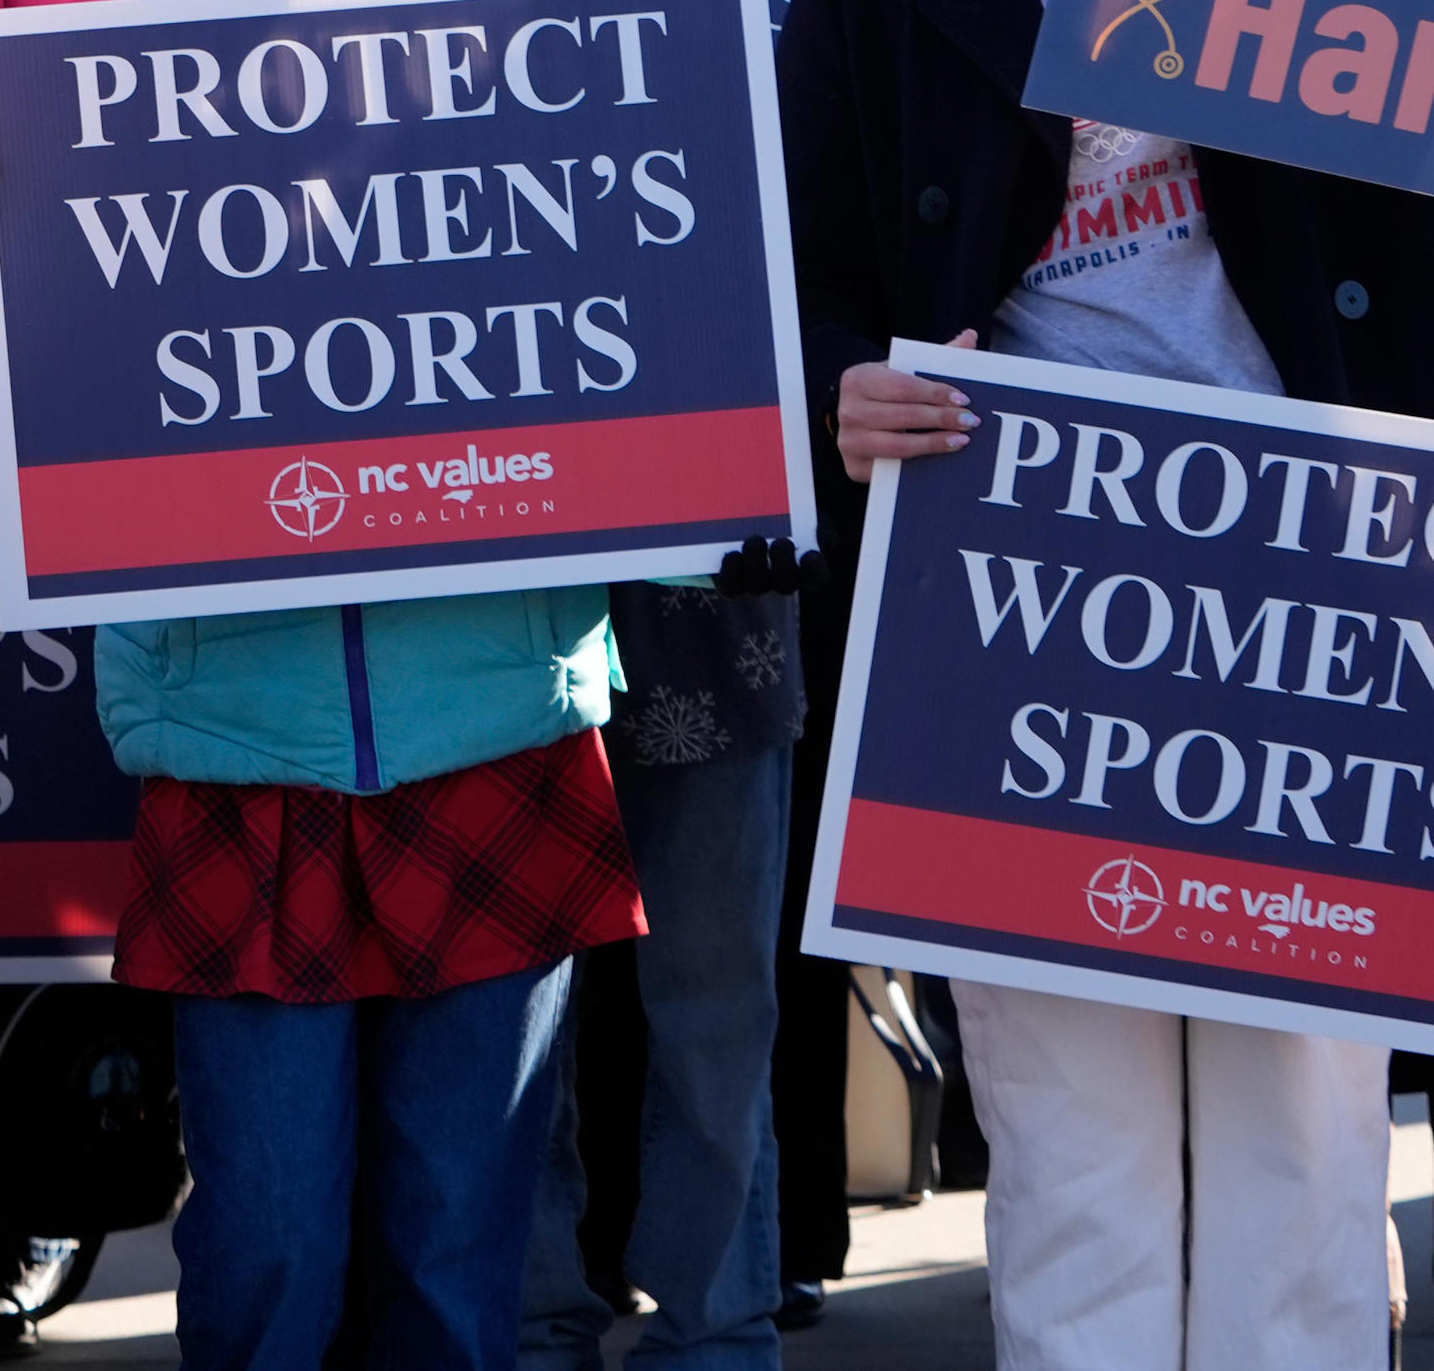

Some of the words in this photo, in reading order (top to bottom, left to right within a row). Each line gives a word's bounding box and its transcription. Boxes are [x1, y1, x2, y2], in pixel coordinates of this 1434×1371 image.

[63, 10, 668, 151] PROTECT
[64, 148, 697, 290] WOMEN'S
[156, 294, 638, 428] SPORTS
[359, 462, 407, 494] nc
[416, 445, 554, 488] values
[363, 499, 555, 528] COALITION
[979, 410, 1434, 569] PROTE
[958, 547, 1434, 714] WOMEN
[1000, 702, 1434, 861] SPORT
[1175, 927, 1367, 969] COALITION
[1179, 876, 1232, 912] nc
[1240, 883, 1376, 935] values
